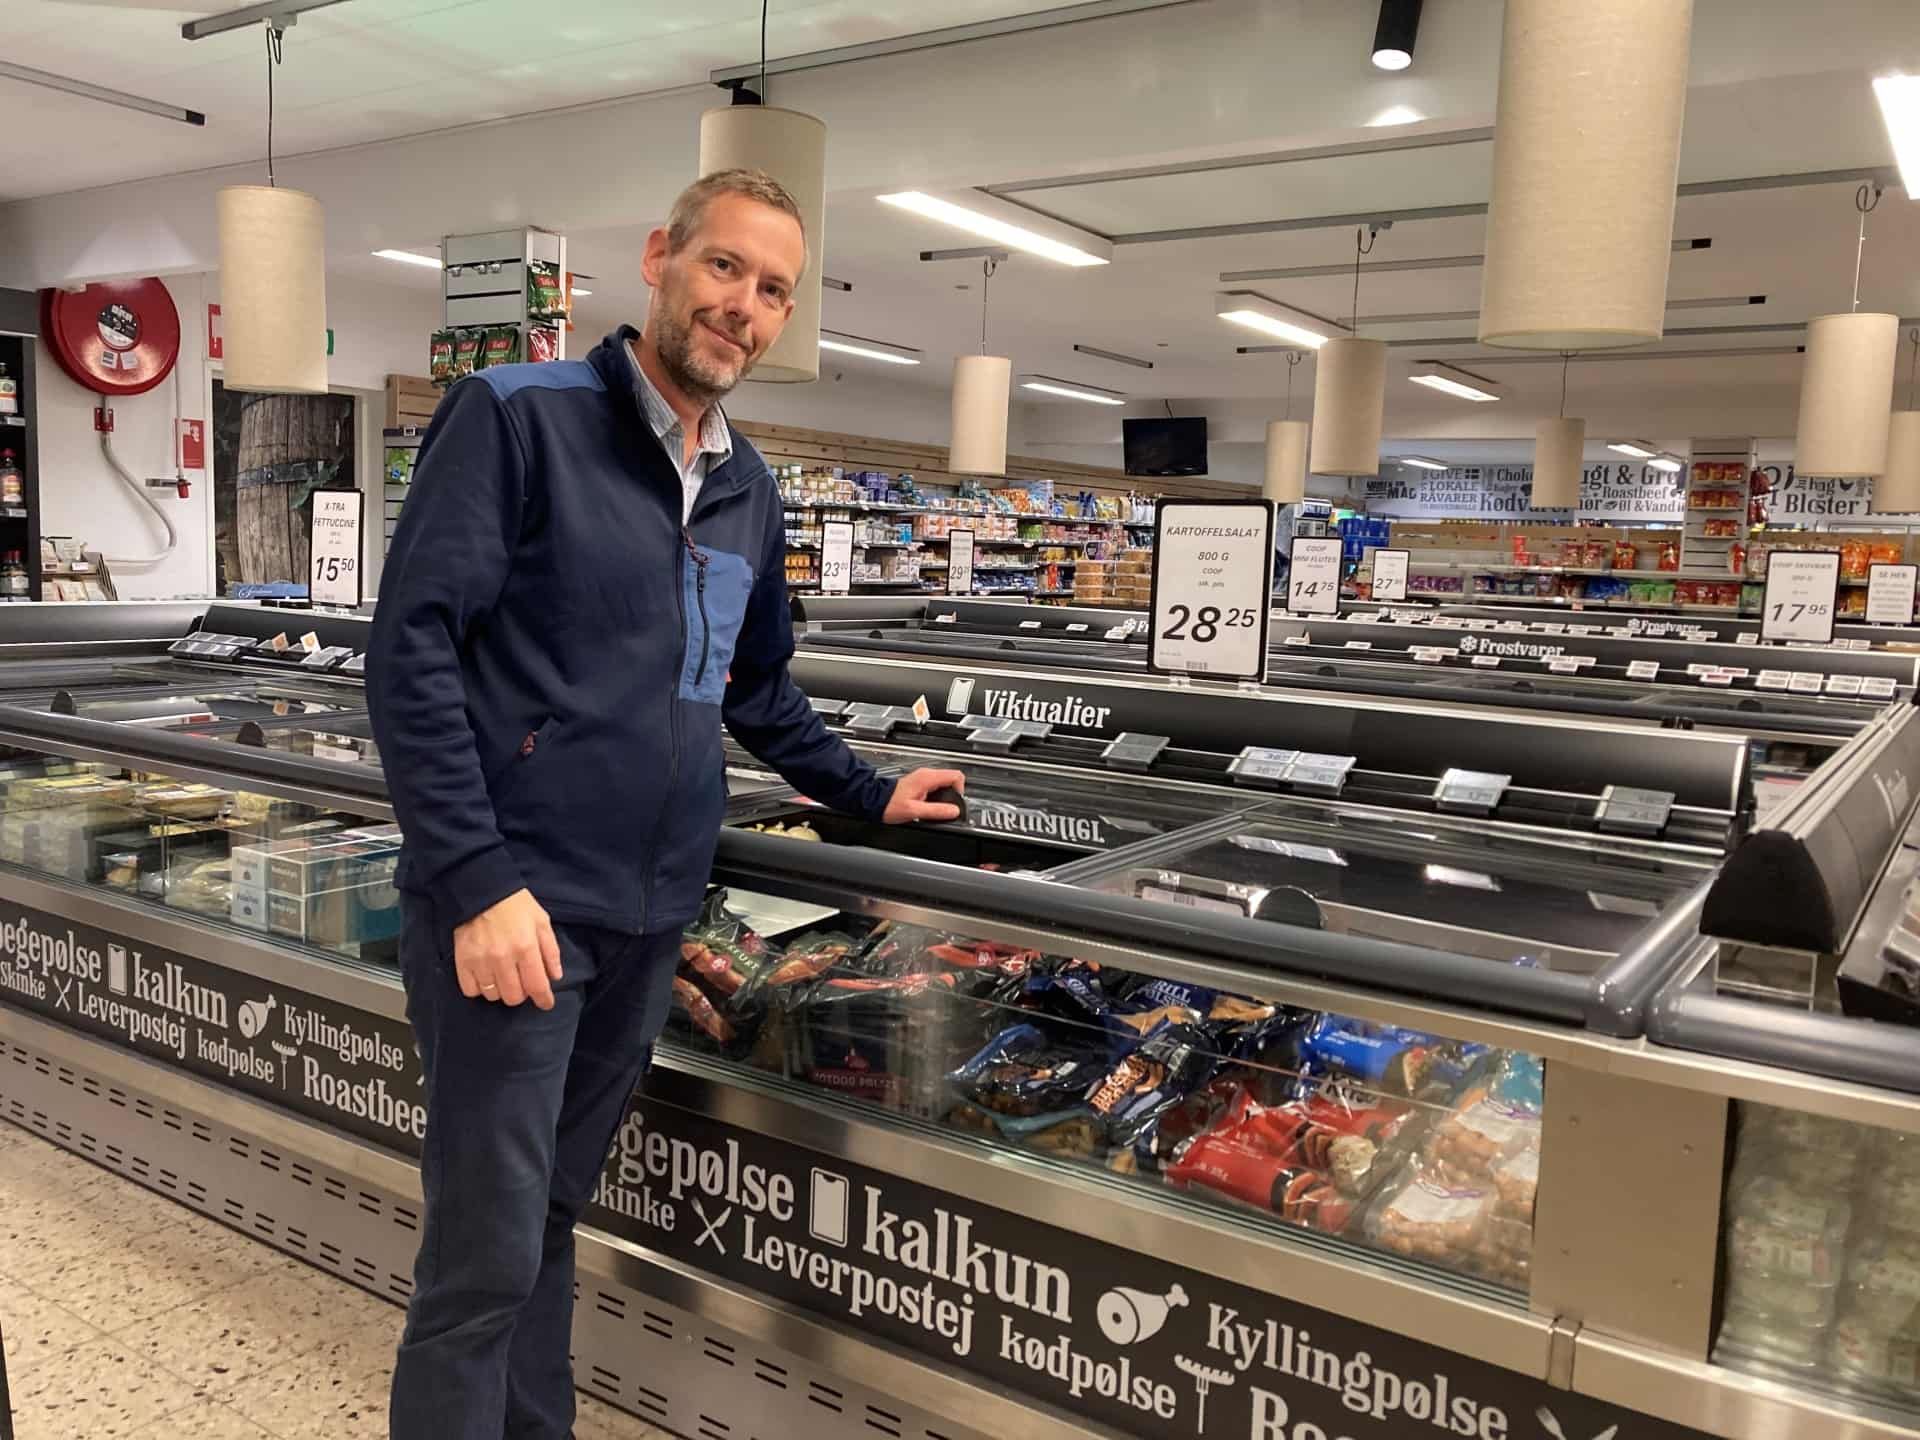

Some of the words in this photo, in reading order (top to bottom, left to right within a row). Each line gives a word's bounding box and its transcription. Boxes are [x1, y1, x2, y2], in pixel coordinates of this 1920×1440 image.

[1603, 486, 1668, 499] Roastbeef
[313, 518, 356, 528] FETTUCCINE
[1166, 526, 1260, 538] KARTOFFELSALAT
[1198, 552, 1218, 561] 800
[1221, 552, 1229, 561] G
[316, 556, 340, 582] 15
[341, 558, 354, 571] 50
[1295, 581, 1318, 597] 14
[1375, 578, 1392, 589] 27
[1772, 603, 1806, 623] 17
[1808, 604, 1827, 615] 95
[1162, 604, 1221, 643] 28
[1225, 608, 1257, 627] 25
[1479, 638, 1565, 657] Frostvarer
[984, 689, 1111, 729] Viktualier
[133, 952, 229, 1029] kalkun
[284, 1004, 404, 1072] Kyllingpølse
[0, 961, 47, 1000] Skinke
[78, 981, 187, 1060] Leverpostej
[198, 1028, 274, 1084] kødpølse
[303, 1056, 427, 1139] Roastbee
[608, 1111, 794, 1222] gepølse
[863, 1186, 1074, 1324] kalkun
[1206, 1303, 1508, 1440] Kyllingpølse
[742, 1215, 976, 1357] Leverpostej
[1001, 1315, 1177, 1418] kødpølse
